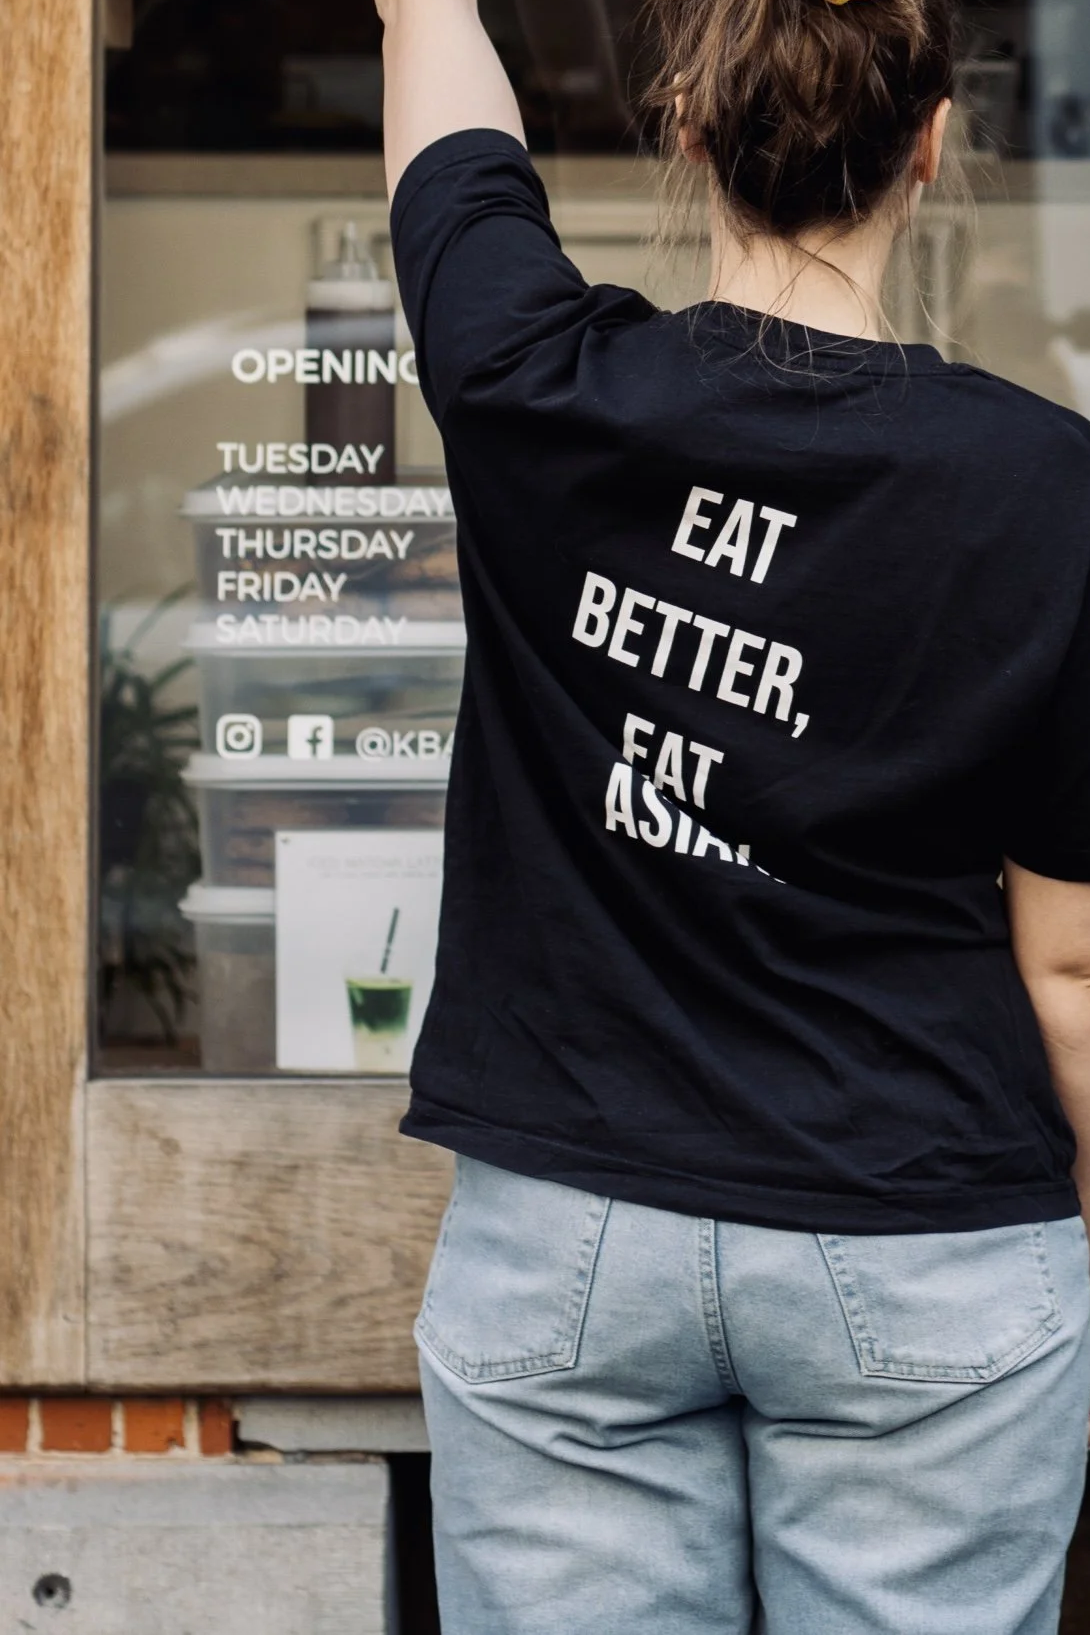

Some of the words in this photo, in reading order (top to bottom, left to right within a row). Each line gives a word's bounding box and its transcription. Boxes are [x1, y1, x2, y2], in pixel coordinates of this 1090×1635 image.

[216, 442, 384, 474] TUESDAY
[216, 485, 451, 517] WEDNESDAY
[216, 528, 414, 560] THURSDAY
[671, 486, 797, 583] EAT
[216, 571, 347, 602] FRIDAY
[215, 614, 407, 644] SATURDAY
[572, 572, 809, 738] BETTER,
